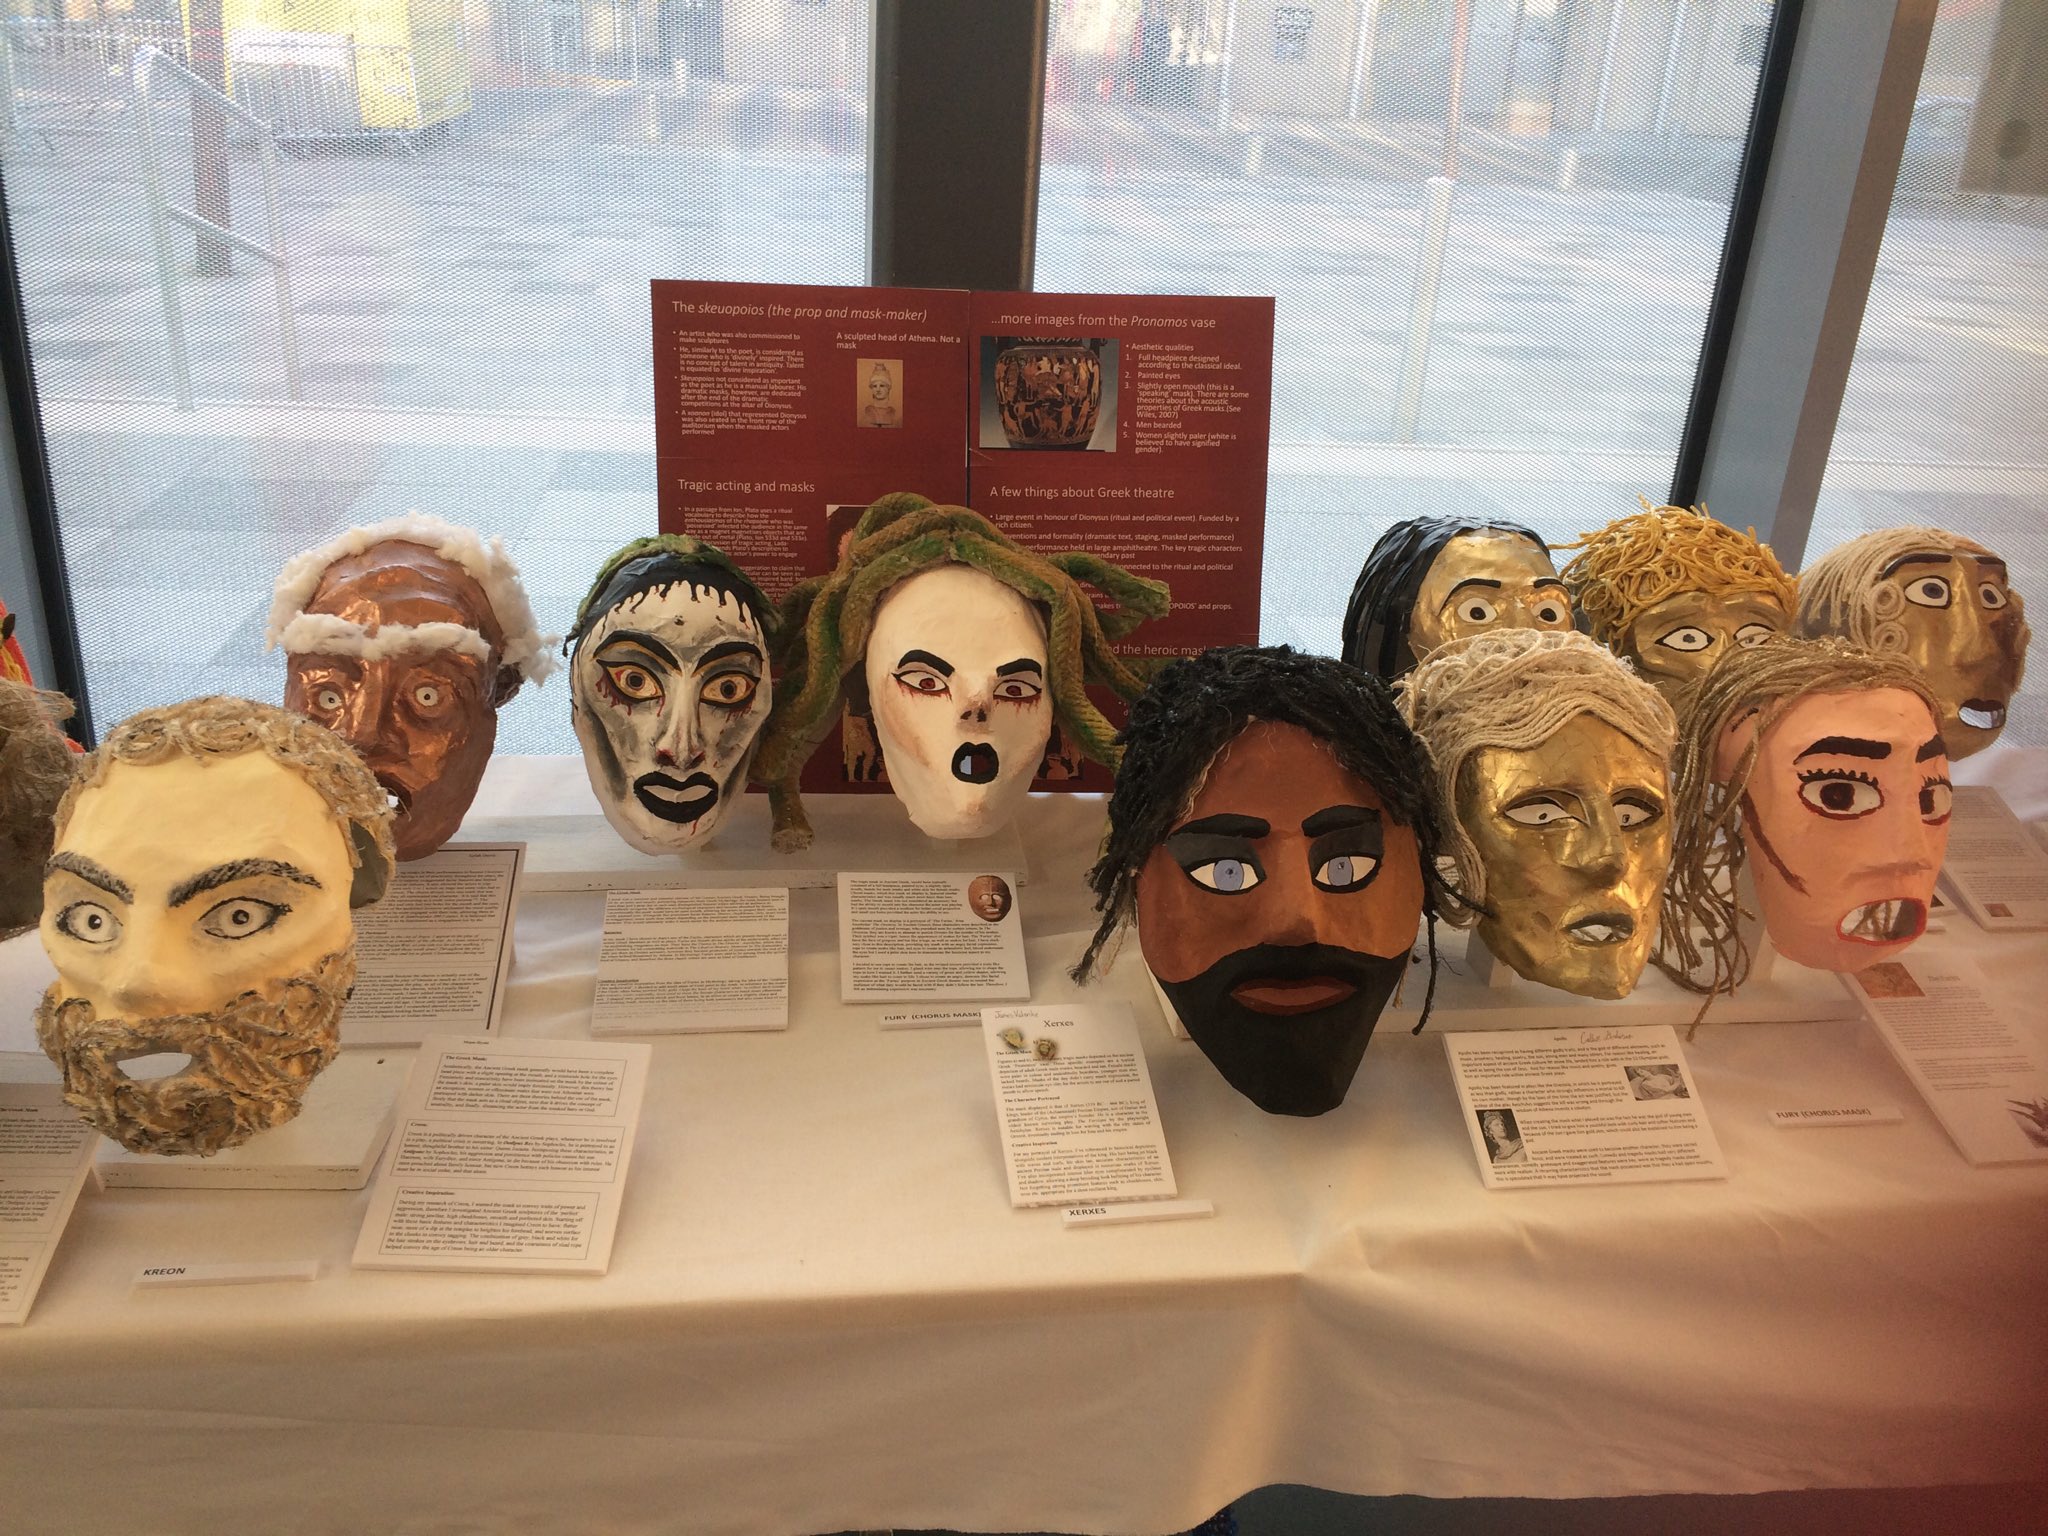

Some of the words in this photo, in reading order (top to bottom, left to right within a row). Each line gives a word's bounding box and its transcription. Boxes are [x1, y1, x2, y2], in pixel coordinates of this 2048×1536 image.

[672, 302, 694, 313] The
[697, 302, 763, 318] skeuopoios
[765, 304, 791, 319] (the
[793, 308, 821, 320] prop
[823, 306, 846, 318] and
[849, 307, 927, 323] mask-maker)
[992, 317, 1033, 325] ...more
[1035, 314, 1077, 328] images
[1079, 315, 1107, 326] from
[1109, 316, 1127, 326] the
[1129, 316, 1189, 327] Pronomos
[843, 332, 876, 343] sculpted
[877, 333, 897, 341] head
[908, 334, 938, 342] Athena.
[939, 335, 954, 343] Not
[837, 341, 856, 349] mask
[1164, 344, 1194, 353] qualities
[1151, 354, 1187, 363] headpiece
[1188, 355, 1219, 363] designed
[1138, 361, 1171, 370] according
[1137, 382, 1162, 391] Slightly
[1206, 383, 1222, 392] (this
[1158, 411, 1178, 419] 2007)
[1163, 432, 1187, 441] slightly
[1188, 432, 1206, 441] paler
[1207, 432, 1229, 441] (white
[1191, 439, 1220, 448] signified
[677, 479, 712, 493] Tragic
[714, 480, 750, 494] acting
[752, 480, 775, 491] and
[777, 481, 815, 492] masks
[990, 486, 1000, 496] A
[1002, 487, 1023, 496] few
[1025, 487, 1060, 499] things
[1062, 487, 1096, 497] about
[1098, 487, 1132, 497] Greek
[1134, 488, 1175, 498] theatre
[995, 514, 1014, 522] Large
[1078, 514, 1109, 523] Dionysus
[1109, 514, 1130, 523] (ritual
[1145, 515, 1172, 523] political
[1173, 515, 1197, 523] event).
[1225, 515, 1233, 523] by
[1052, 533, 1083, 541] formality
[1084, 533, 1116, 542] (dramatic
[1134, 533, 1160, 542] staging,
[1188, 534, 1234, 542] performance)
[1093, 544, 1111, 552] large
[1112, 544, 1160, 553] amphitheatre.
[1174, 545, 1186, 553] key
[1187, 545, 1206, 553] tragic
[1097, 552, 1119, 560] endary
[1206, 564, 1233, 572] political
[1123, 644, 1142, 654] the
[1144, 644, 1179, 655] heroic
[1802, 1110, 1840, 1118] (CHORUS
[1069, 1208, 1106, 1216] XERXES
